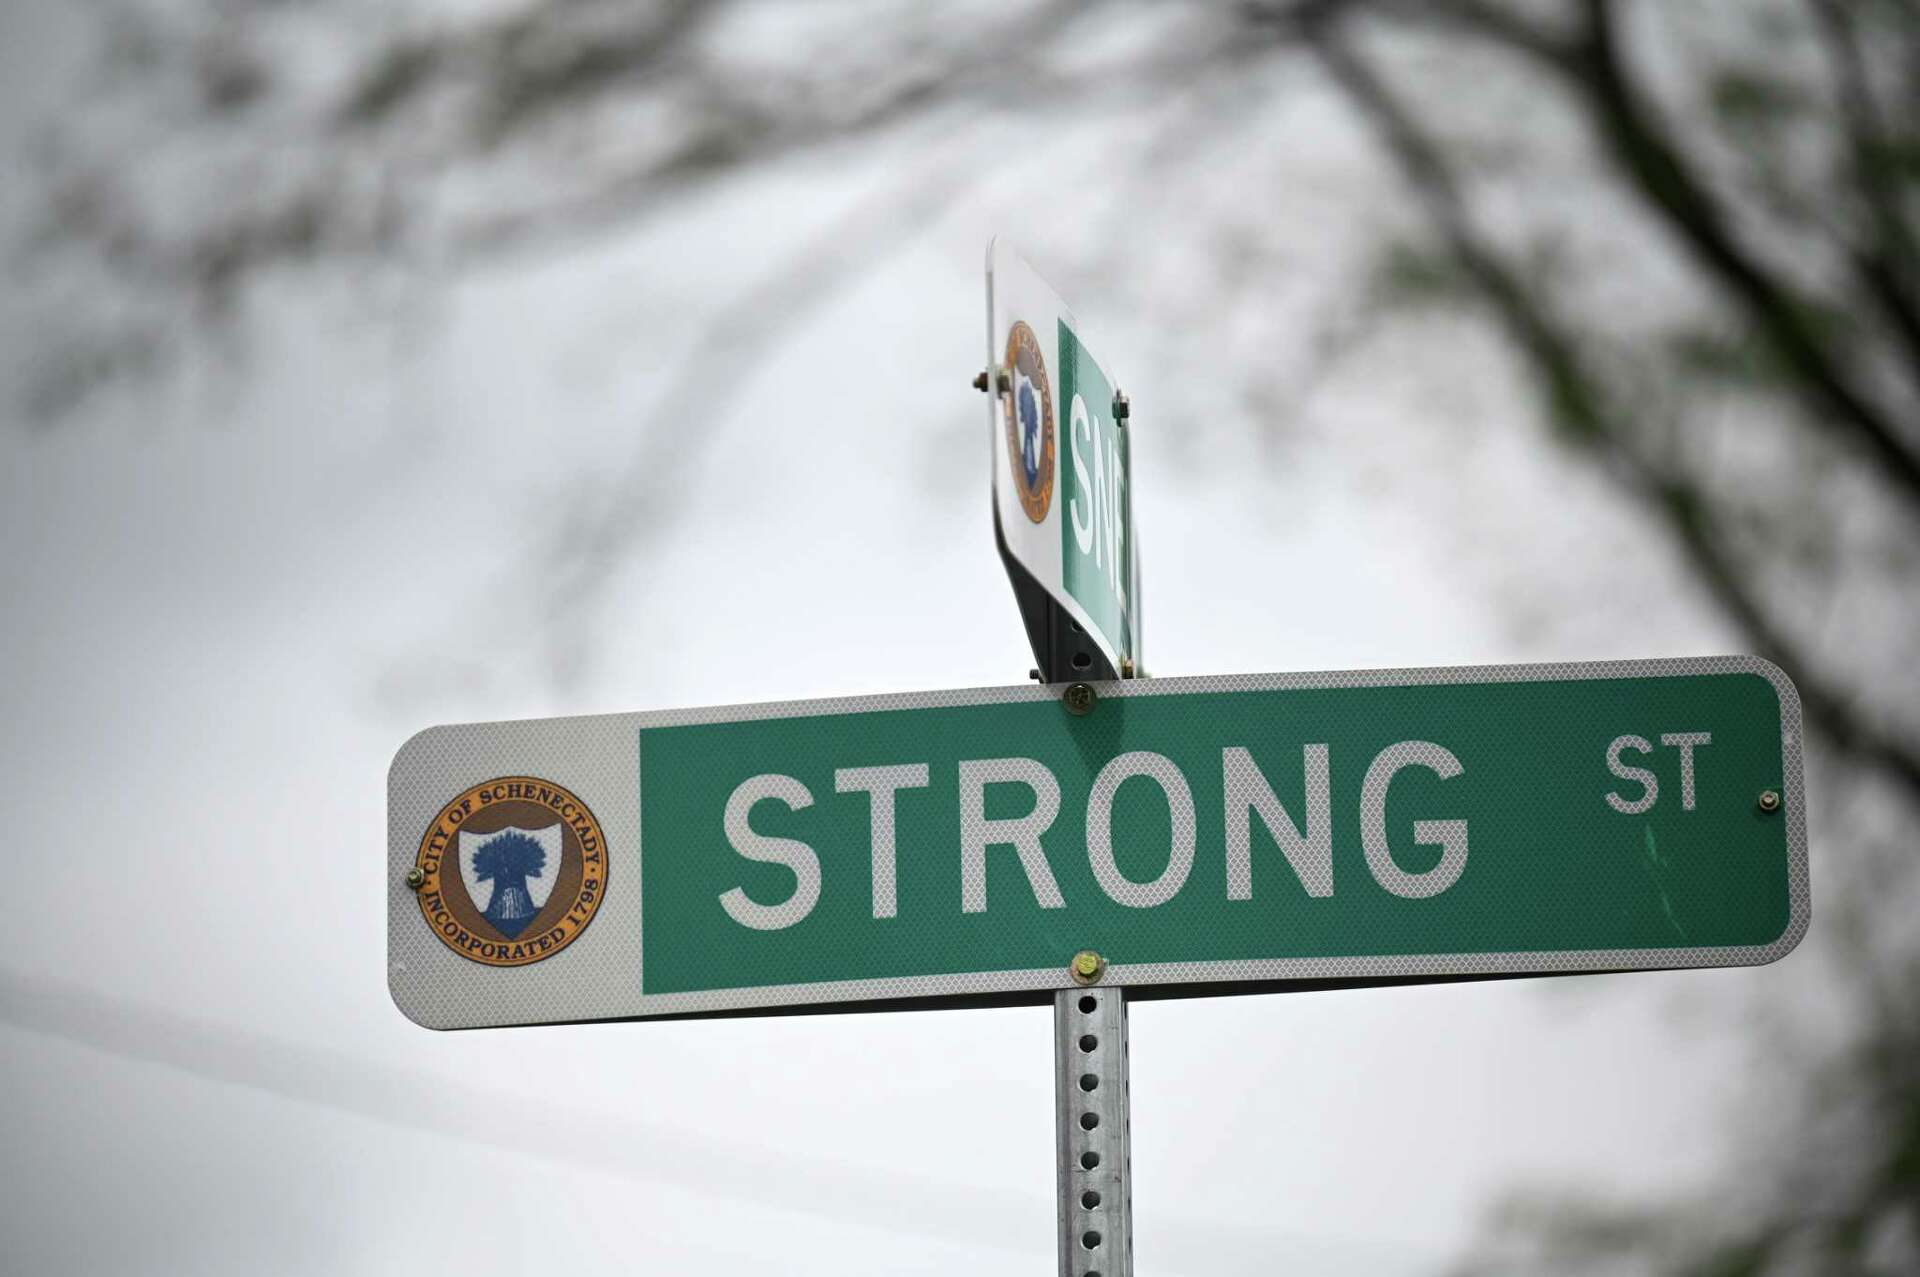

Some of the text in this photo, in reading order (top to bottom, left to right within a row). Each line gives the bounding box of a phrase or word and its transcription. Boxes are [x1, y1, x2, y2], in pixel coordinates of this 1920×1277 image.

[423, 783, 601, 875] CITY OF SCHENECTADY
[718, 731, 1712, 931] STRONG ST
[423, 879, 599, 960] INCORPORATED 1798
